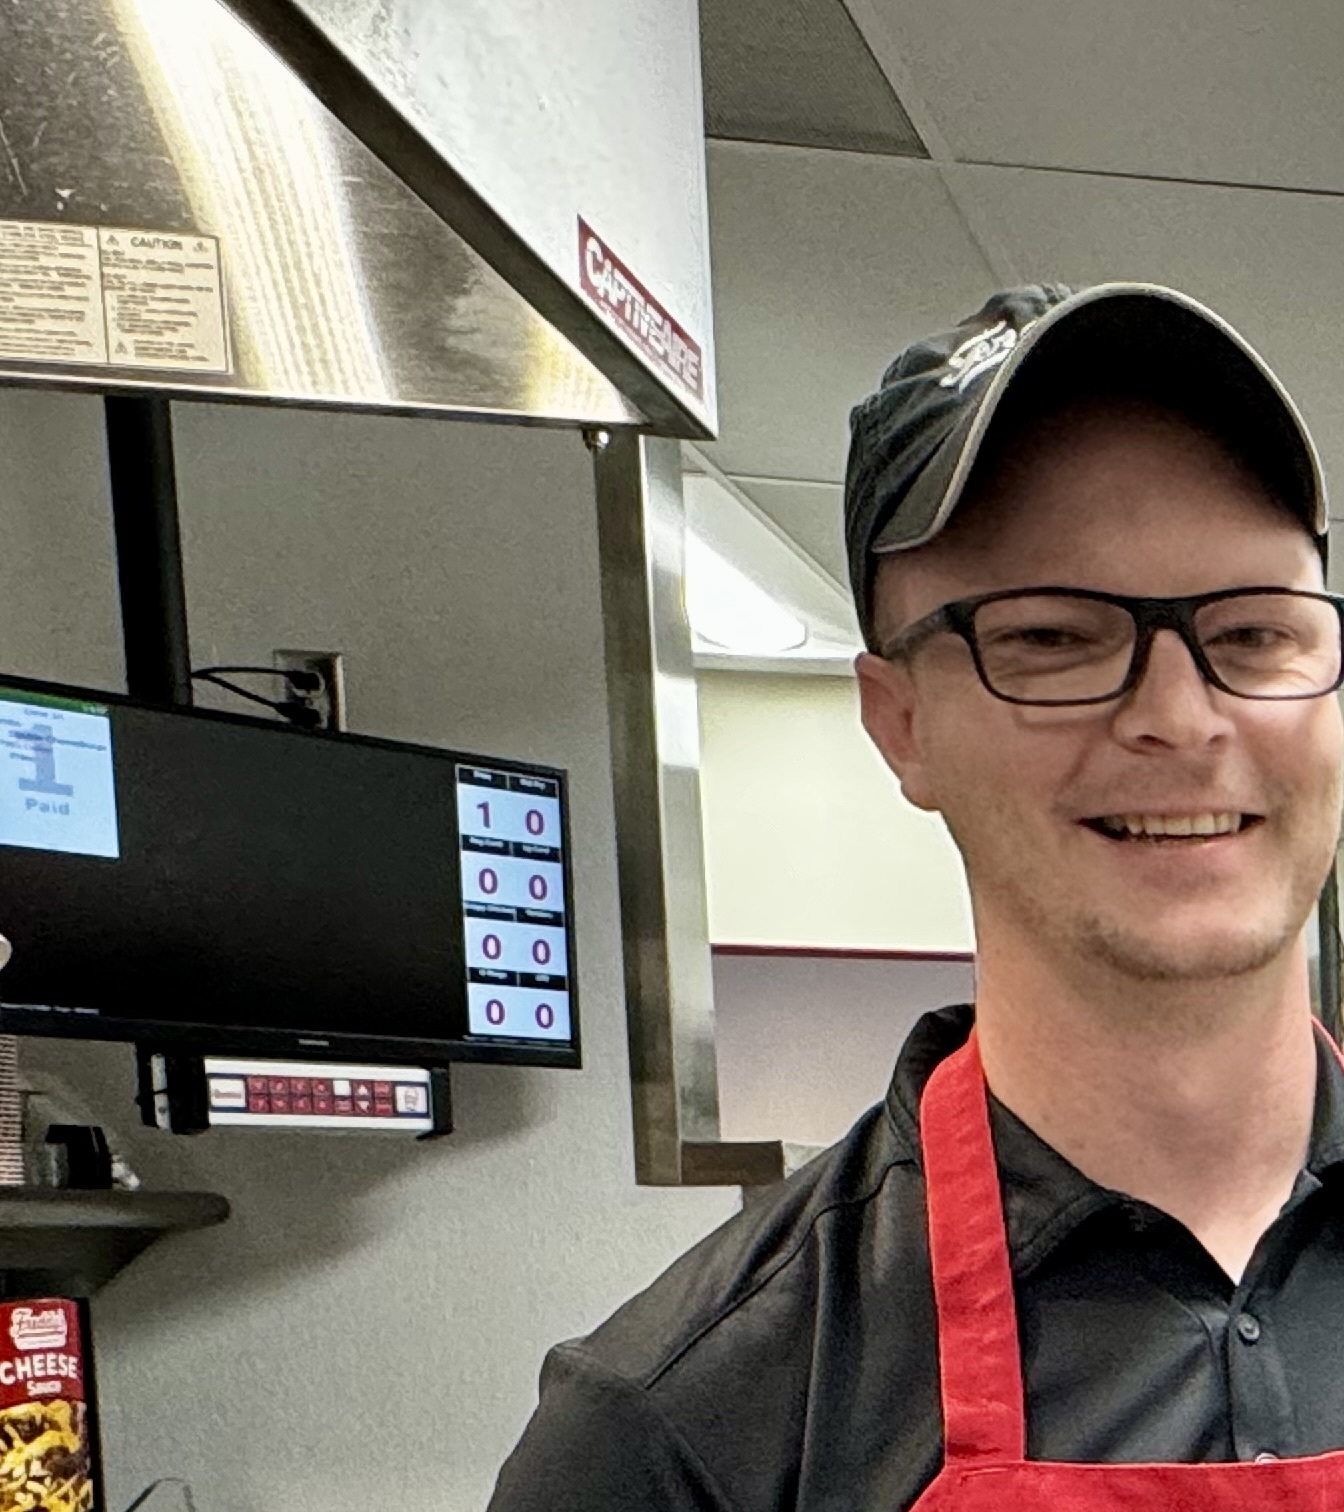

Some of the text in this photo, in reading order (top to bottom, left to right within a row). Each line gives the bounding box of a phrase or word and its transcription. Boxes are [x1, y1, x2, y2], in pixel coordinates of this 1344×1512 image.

[25, 797, 70, 816] Paid
[477, 801, 544, 836] 1 0
[479, 868, 548, 901] 0 0
[482, 934, 551, 965] 0 0
[486, 999, 554, 1029] 0 0
[0, 1352, 78, 1386] CHEESE
